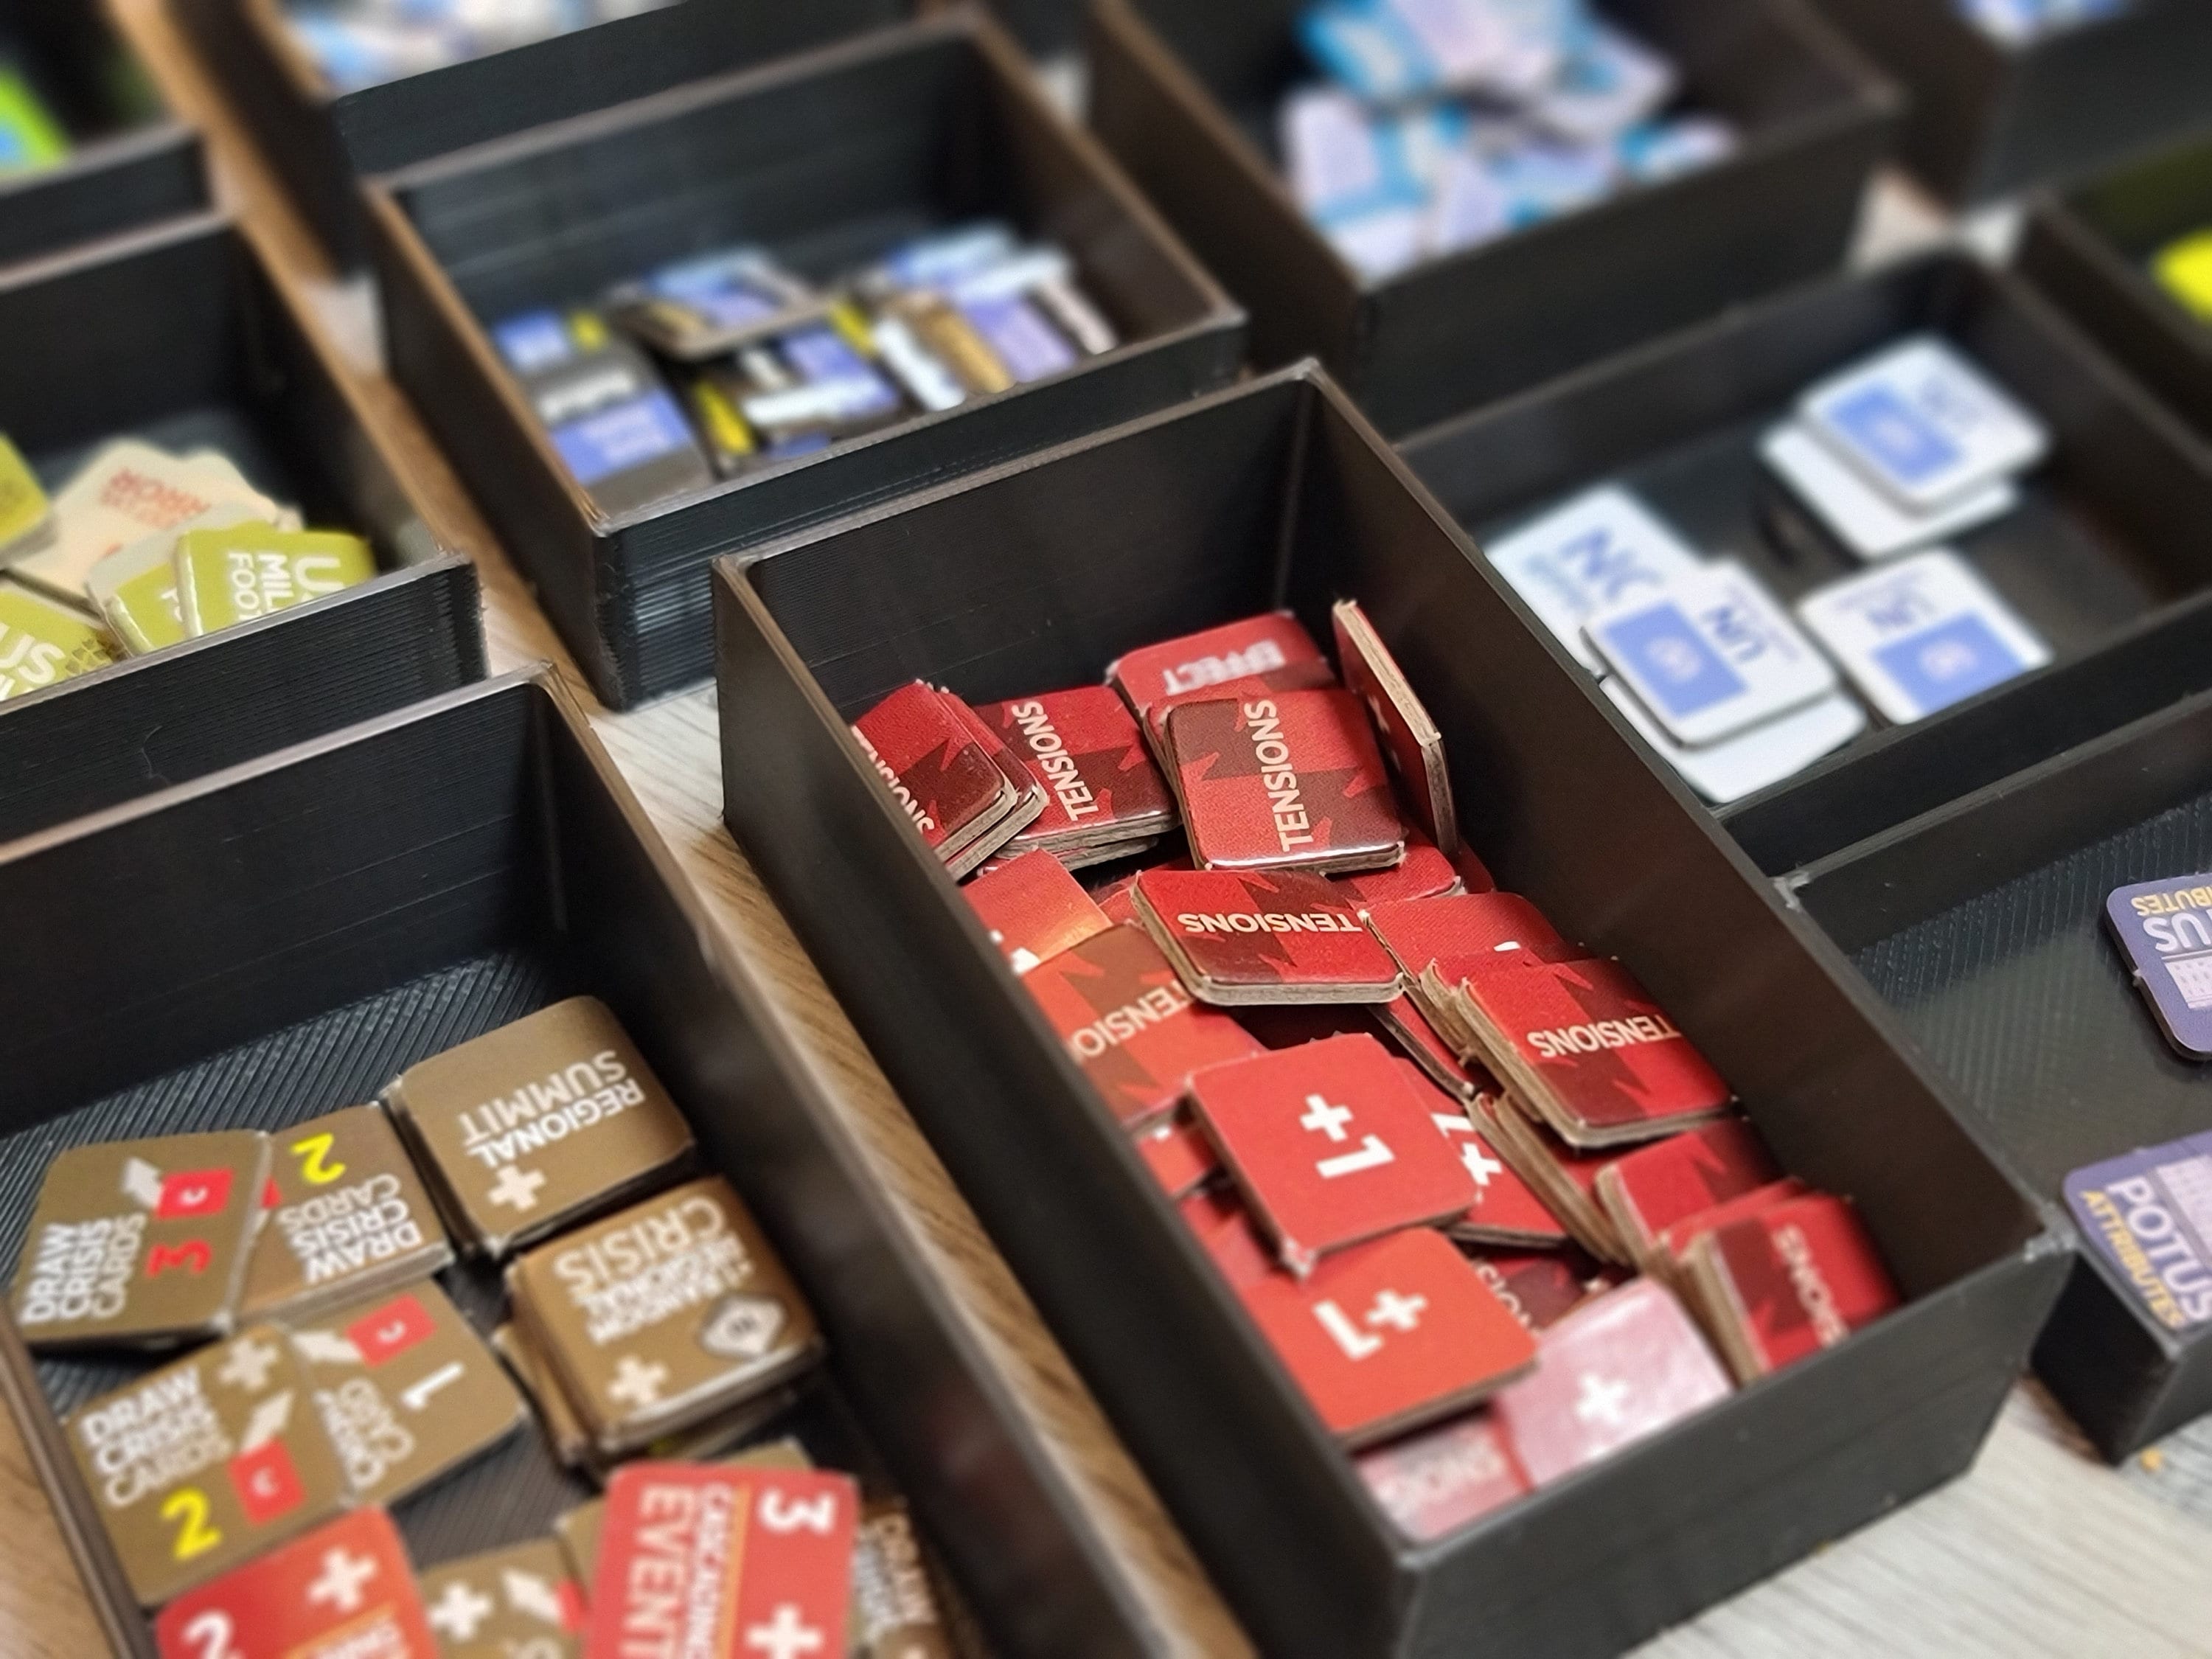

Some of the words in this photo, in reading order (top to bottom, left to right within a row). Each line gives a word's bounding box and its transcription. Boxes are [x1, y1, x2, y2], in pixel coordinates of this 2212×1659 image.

[1012, 701, 1099, 821] TENSIONS
[1244, 699, 1313, 852] TENSIONS
[1178, 913, 1363, 935] TENSIONS
[1526, 1014, 1682, 1058] TENSIONS
[458, 1049, 627, 1144] SUMMIT
[467, 1077, 646, 1169] REGIONAL
[290, 1132, 347, 1185] 2
[275, 1171, 404, 1237] CARDS
[289, 1195, 411, 1260] CRISIS
[21, 1224, 77, 1321] DRAW
[58, 1222, 111, 1315] CRISIS
[91, 1217, 145, 1315] CARDS
[146, 1240, 212, 1277] 3
[305, 1220, 423, 1285] DRAW
[550, 1194, 728, 1300] CRISIS
[2080, 1189, 2186, 1329] ATTRIBUTES
[2106, 1175, 2212, 1320] POTUS
[82, 1368, 197, 1444] DRAW
[402, 1360, 465, 1411] 1
[160, 1486, 222, 1561] 2
[759, 1489, 838, 1534] 3
